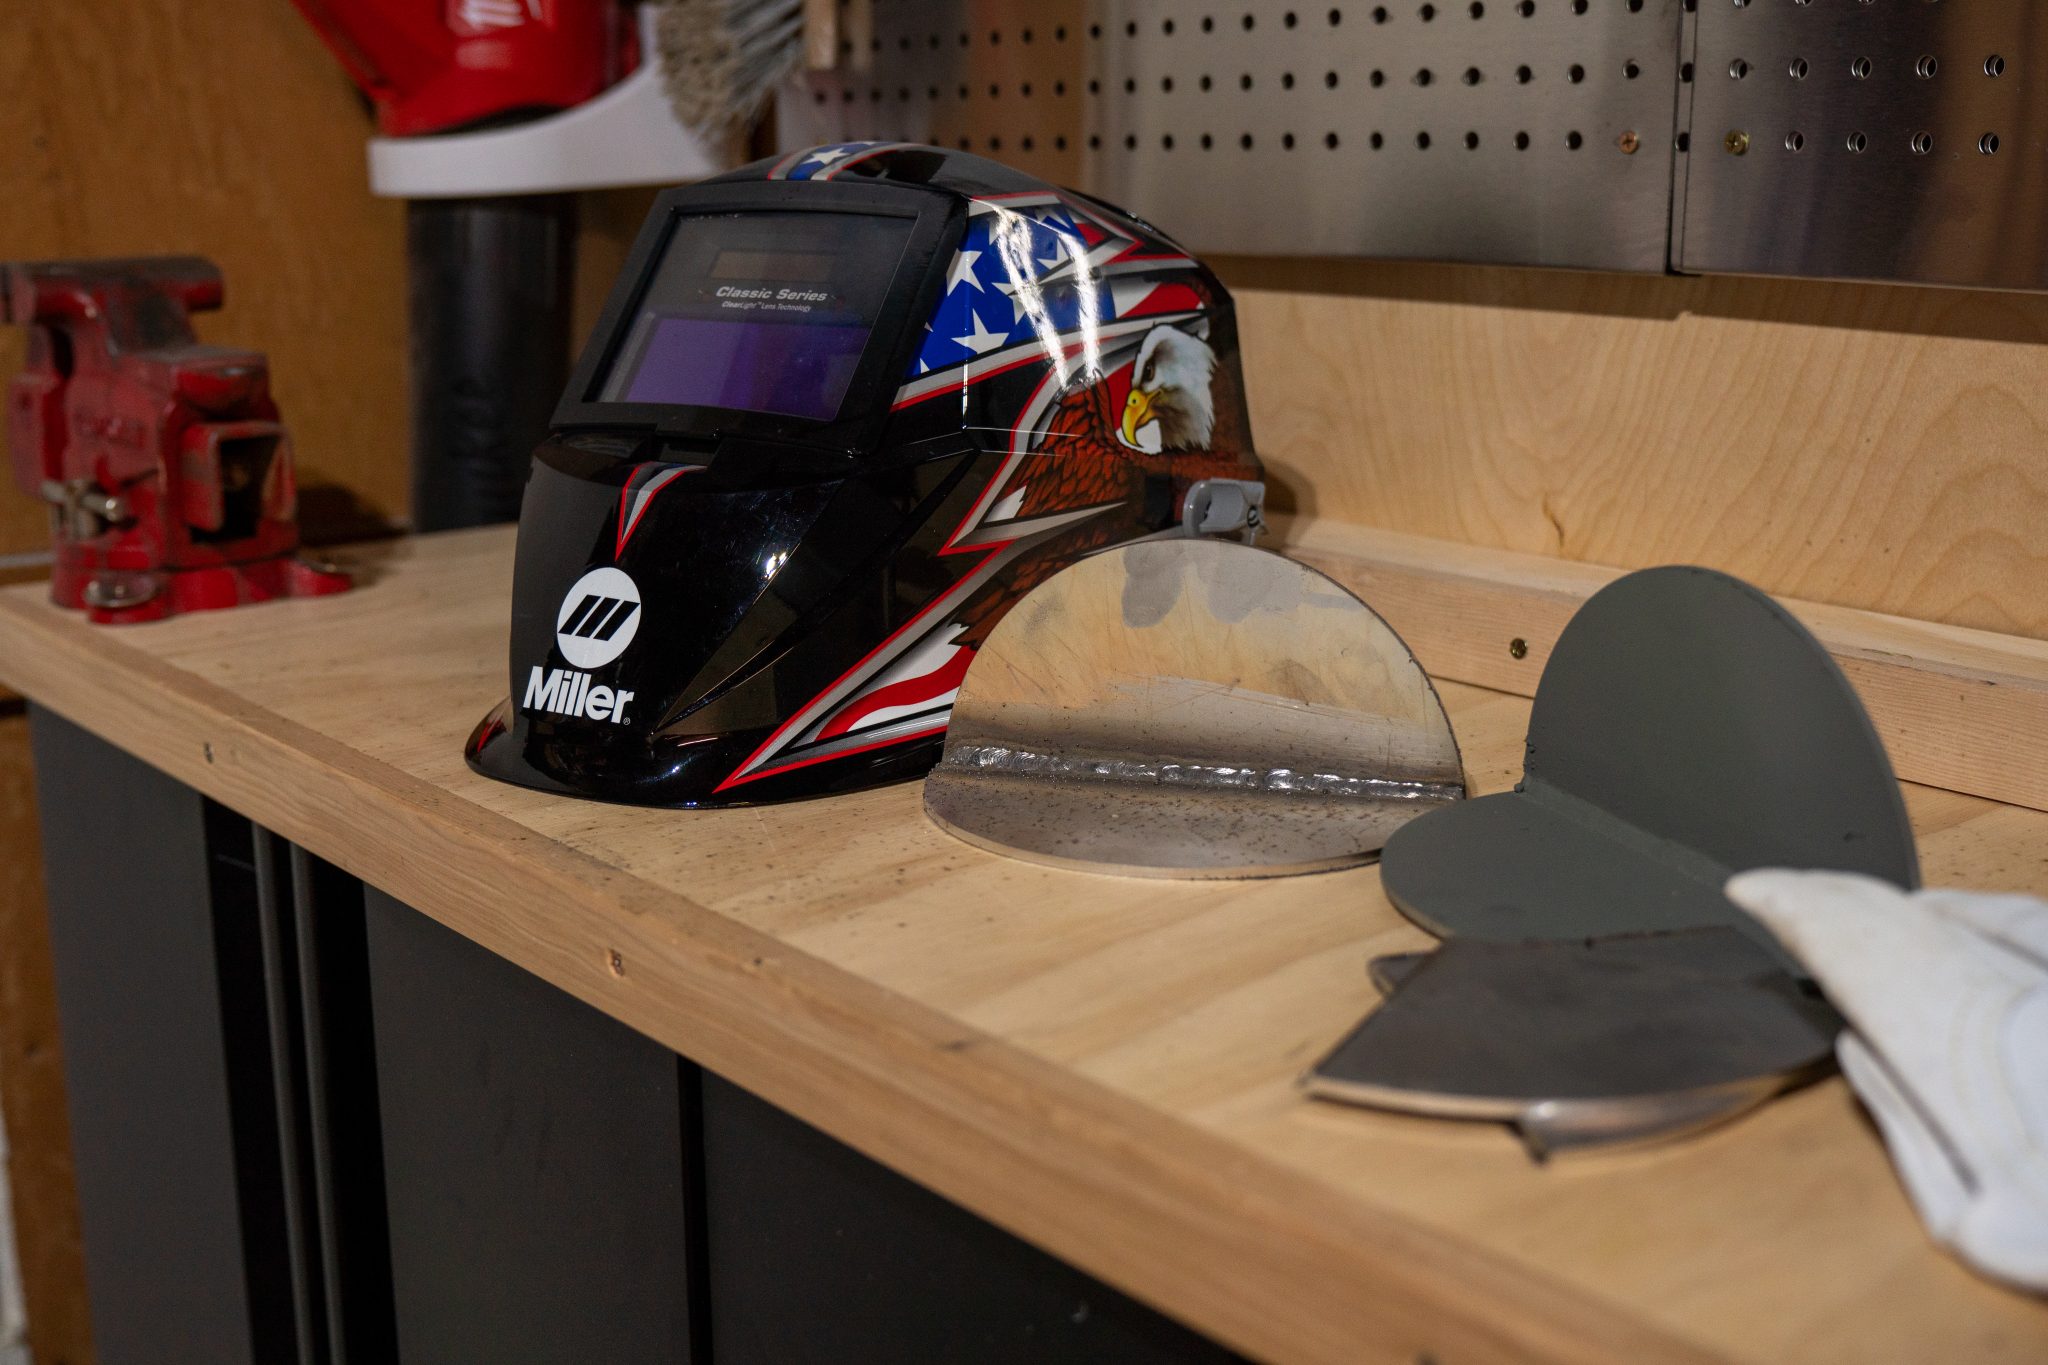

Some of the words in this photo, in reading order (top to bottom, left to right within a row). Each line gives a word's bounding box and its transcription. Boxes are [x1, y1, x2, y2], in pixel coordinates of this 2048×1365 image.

[716, 286, 772, 299] Classic
[776, 288, 828, 301] Series
[761, 302, 776, 311] Lens
[777, 303, 812, 313] Technology
